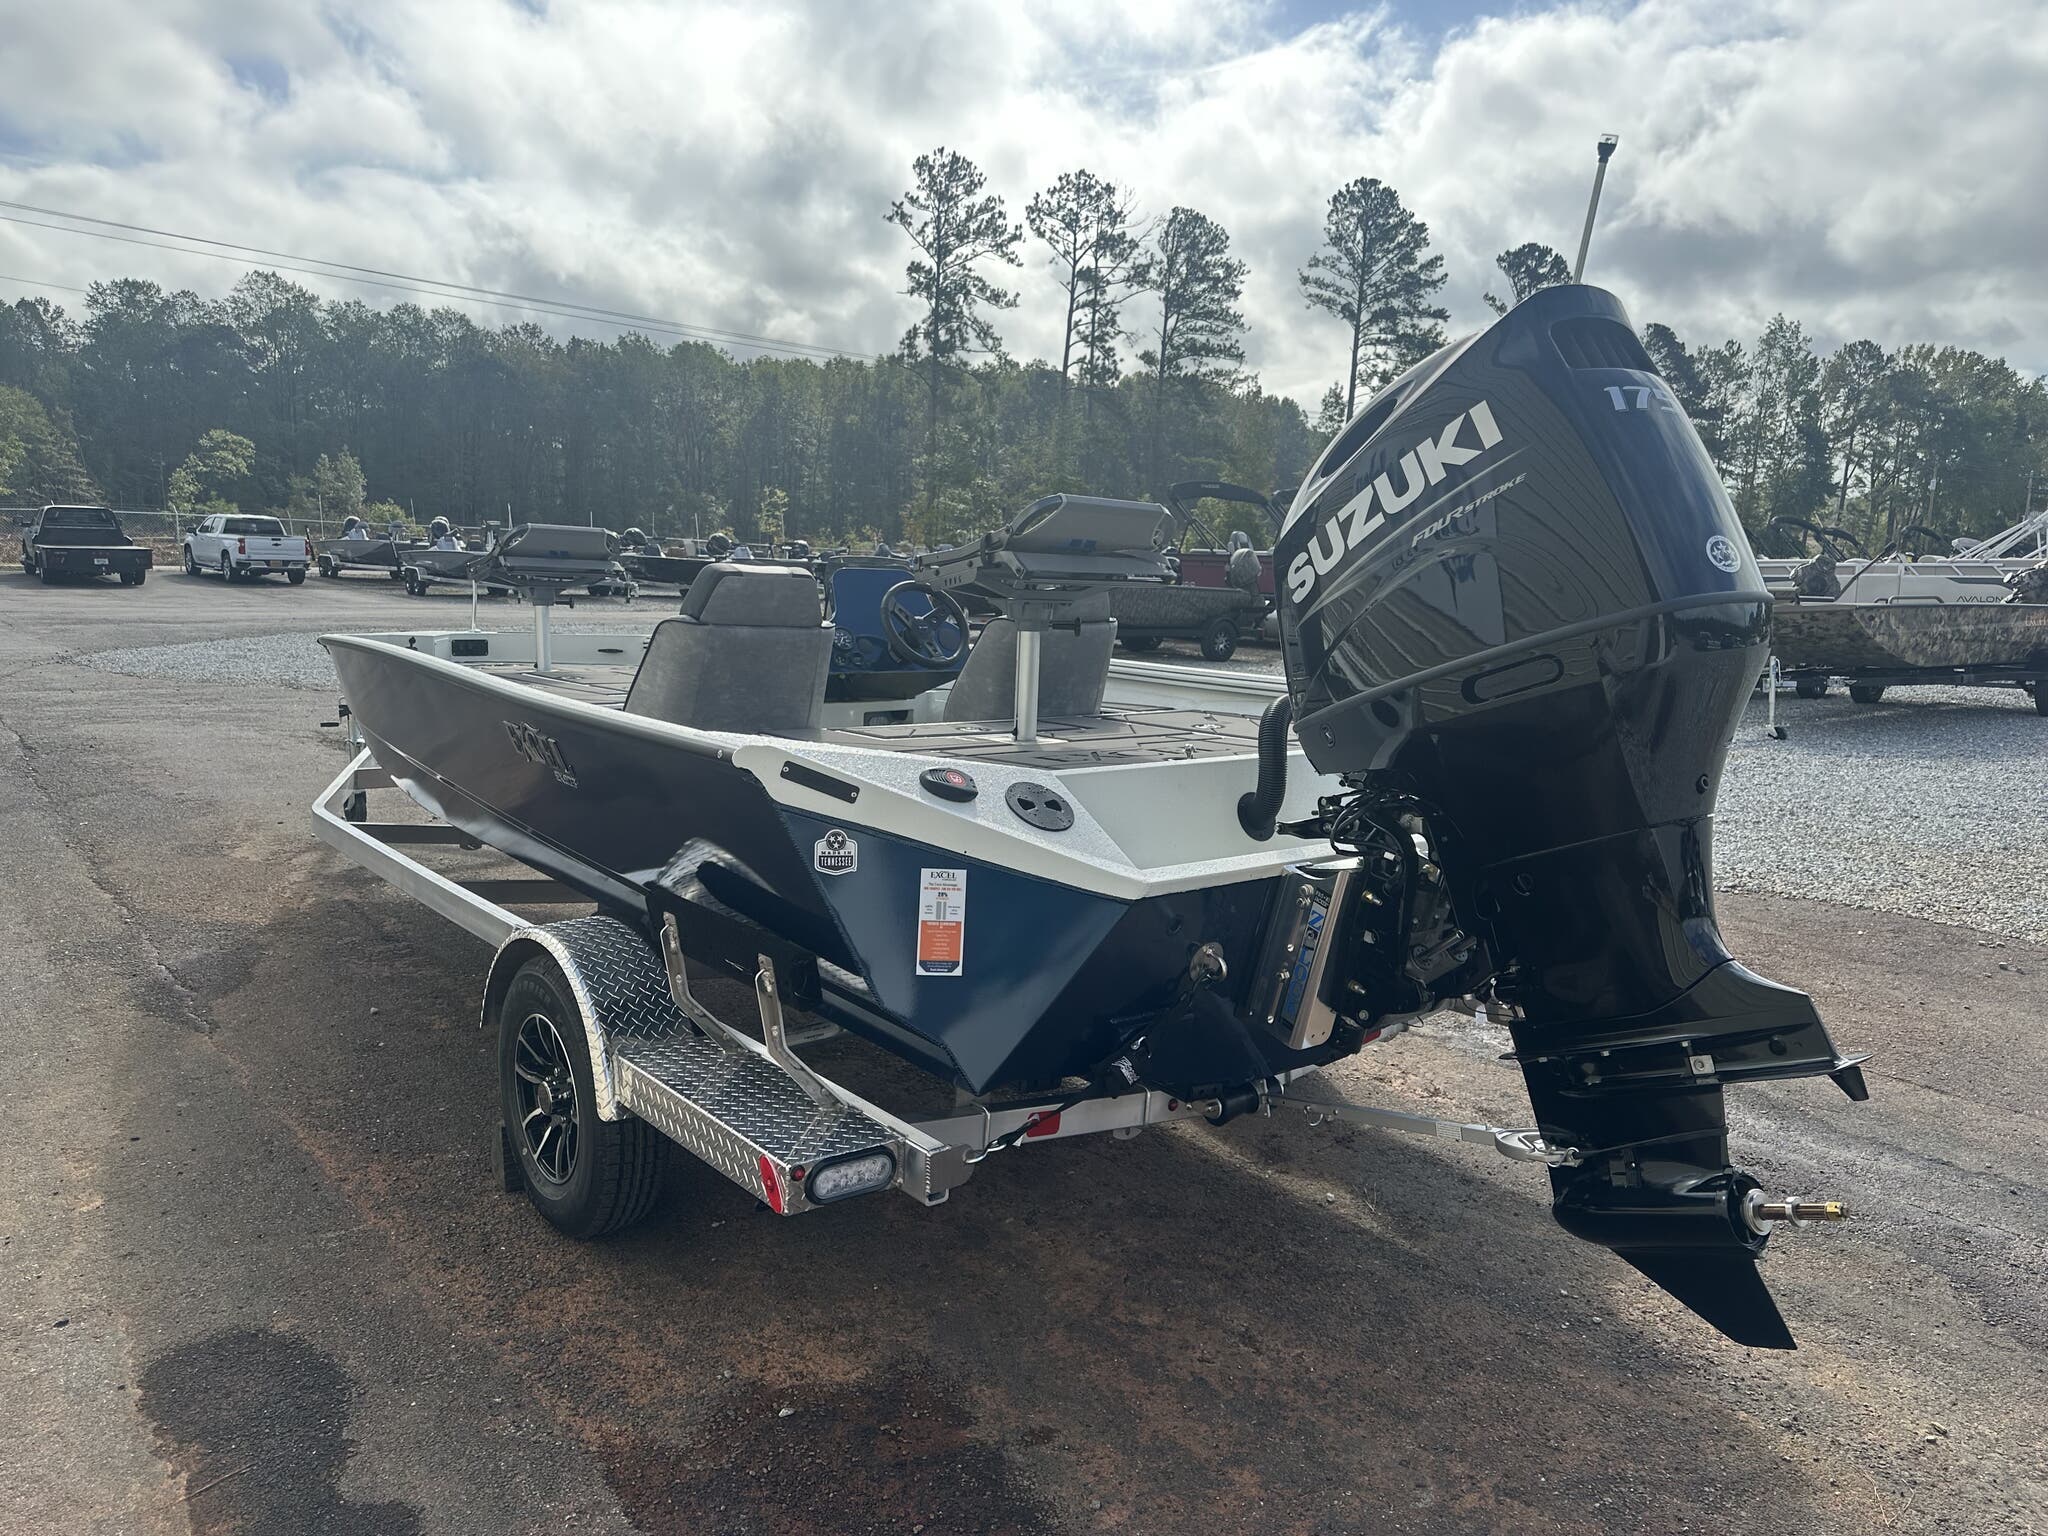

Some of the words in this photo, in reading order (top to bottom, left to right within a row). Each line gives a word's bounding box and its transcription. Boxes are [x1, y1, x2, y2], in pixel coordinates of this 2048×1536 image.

[1287, 400, 1503, 604] SUZUKI
[1956, 595, 2004, 604] AVALON
[820, 856, 852, 867] TENNESSEE
[930, 871, 957, 879] EXCEL
